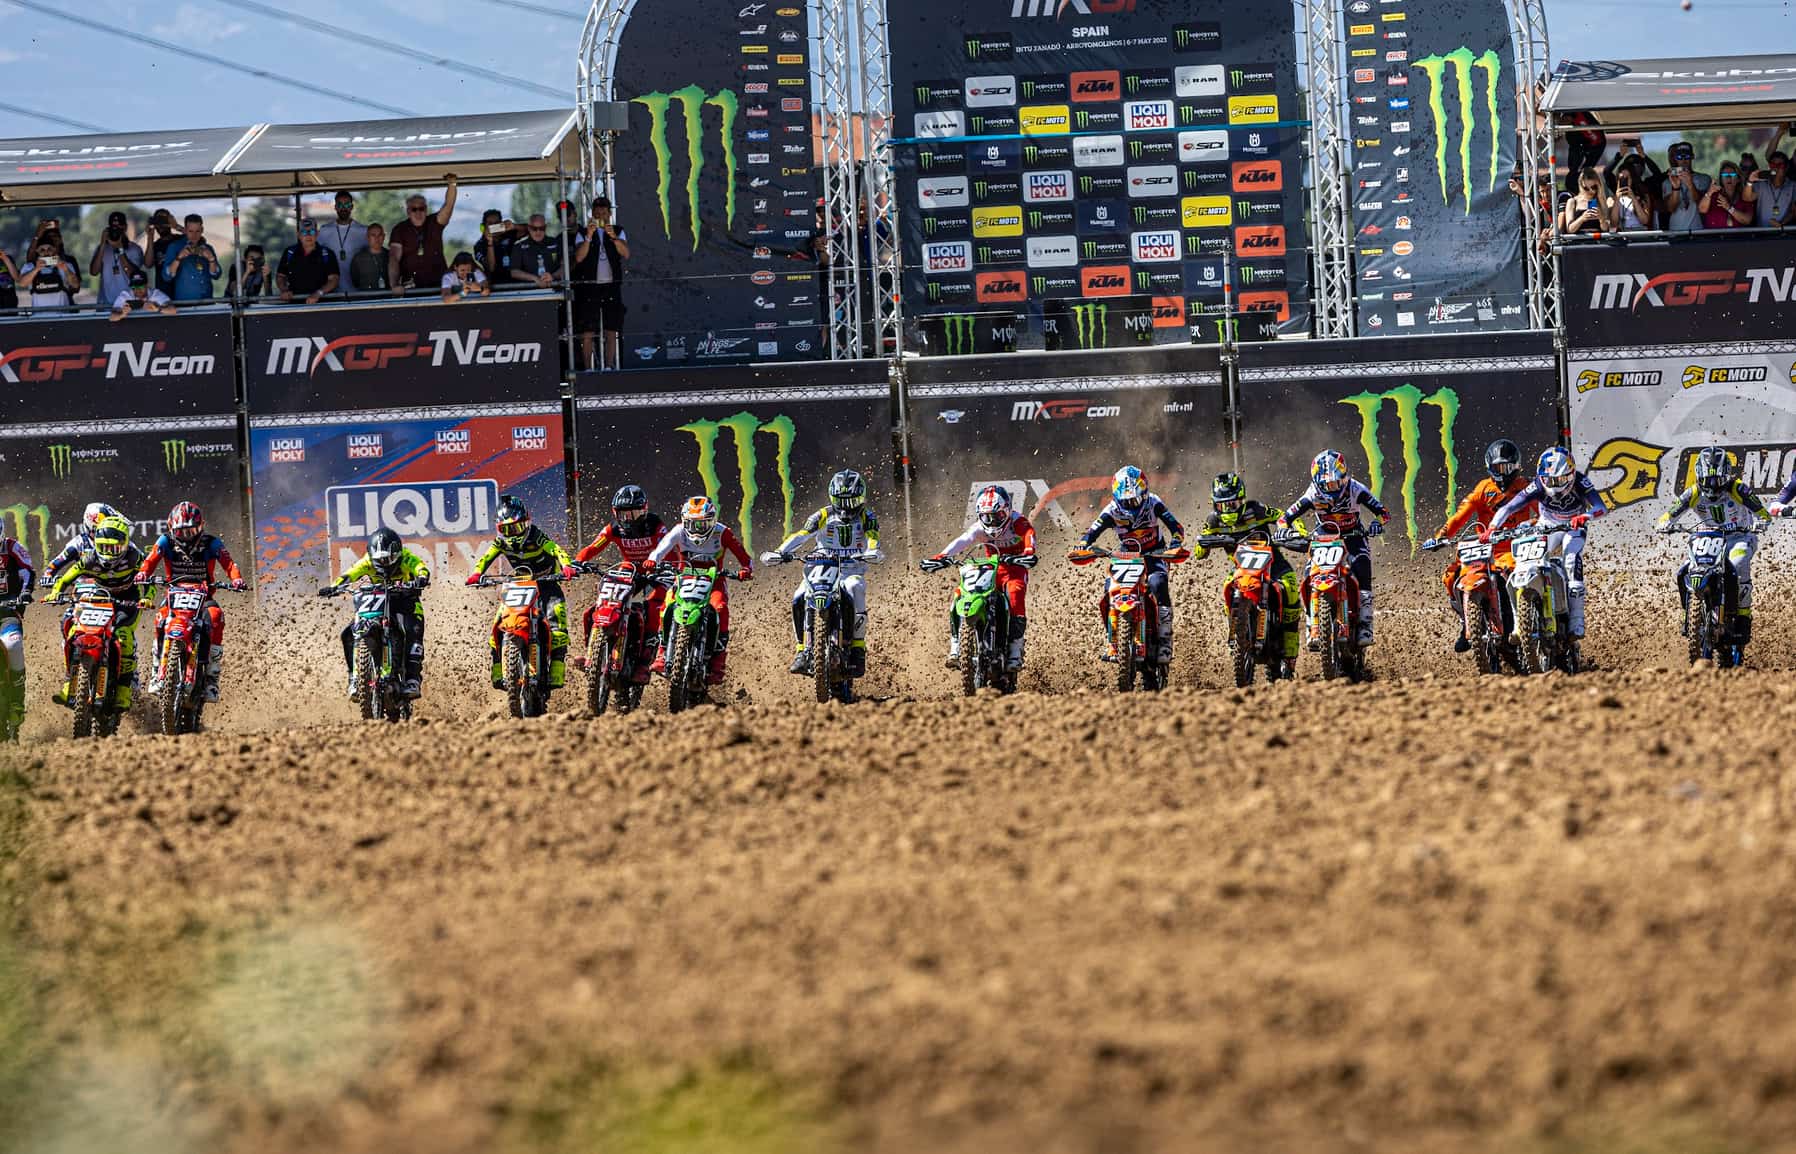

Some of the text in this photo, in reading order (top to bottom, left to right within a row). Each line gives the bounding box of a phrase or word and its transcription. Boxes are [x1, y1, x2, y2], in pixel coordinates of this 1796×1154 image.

[1072, 26, 1109, 37] SPAIN
[1077, 80, 1114, 93] KTM
[1132, 104, 1167, 115] LIQUI
[1132, 116, 1167, 127] MOLY
[1031, 175, 1064, 187] LIQUI
[1238, 169, 1276, 183] KTM
[1032, 187, 1067, 198] MOLY
[1139, 235, 1172, 246] LIQUI
[1242, 234, 1279, 248] KTM
[930, 246, 963, 258] LIQUI
[1140, 247, 1175, 257] MOLY
[929, 258, 966, 269] MOLY
[983, 280, 1020, 294] KTM
[1088, 275, 1125, 288] KTM
[1247, 301, 1282, 312] KTM
[1163, 401, 1193, 413] infront
[436, 430, 469, 443] LIQUI
[513, 427, 545, 439] LIQUI
[271, 439, 302, 450] LIQUI
[349, 434, 381, 447] LIQUI
[514, 438, 546, 450] MOLY
[71, 448, 119, 459] MONSTER
[186, 443, 234, 453] MONSTER
[350, 446, 382, 457] MOLY
[437, 442, 469, 453] MOLY
[271, 450, 304, 462] MOLY
[336, 486, 490, 538] LIQUI
[1312, 547, 1343, 565] 80
[1460, 545, 1491, 562] 253
[1517, 541, 1546, 560] 96
[808, 565, 838, 584] 44
[963, 566, 996, 592] 24
[1111, 564, 1144, 582] 72
[600, 582, 632, 600] 517
[679, 578, 712, 599] 22
[359, 594, 385, 612] 27
[505, 588, 535, 607] 51
[79, 609, 112, 625] 696
